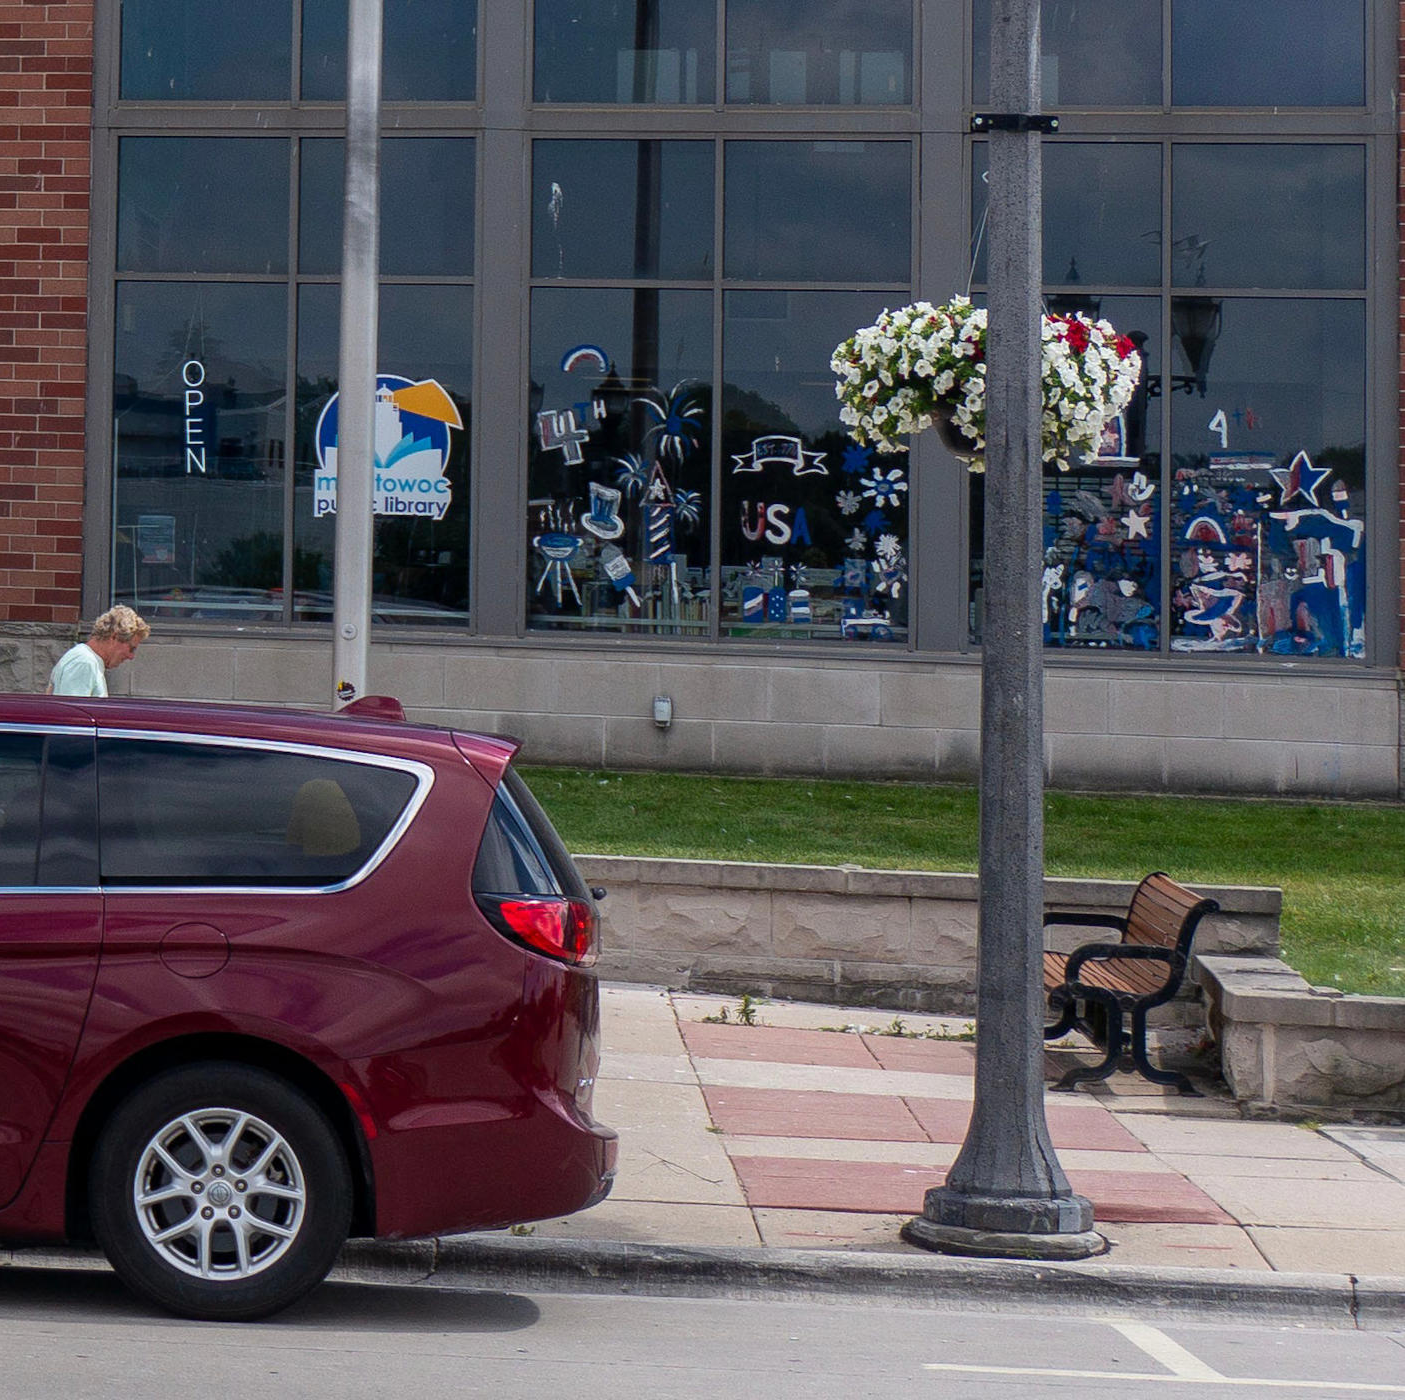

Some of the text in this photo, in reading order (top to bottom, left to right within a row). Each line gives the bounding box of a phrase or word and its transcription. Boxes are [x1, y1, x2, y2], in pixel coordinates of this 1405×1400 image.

[182, 360, 206, 474] OPEN
[317, 473, 449, 494] mtowoc
[385, 496, 448, 518] library
[741, 500, 812, 545] USA
